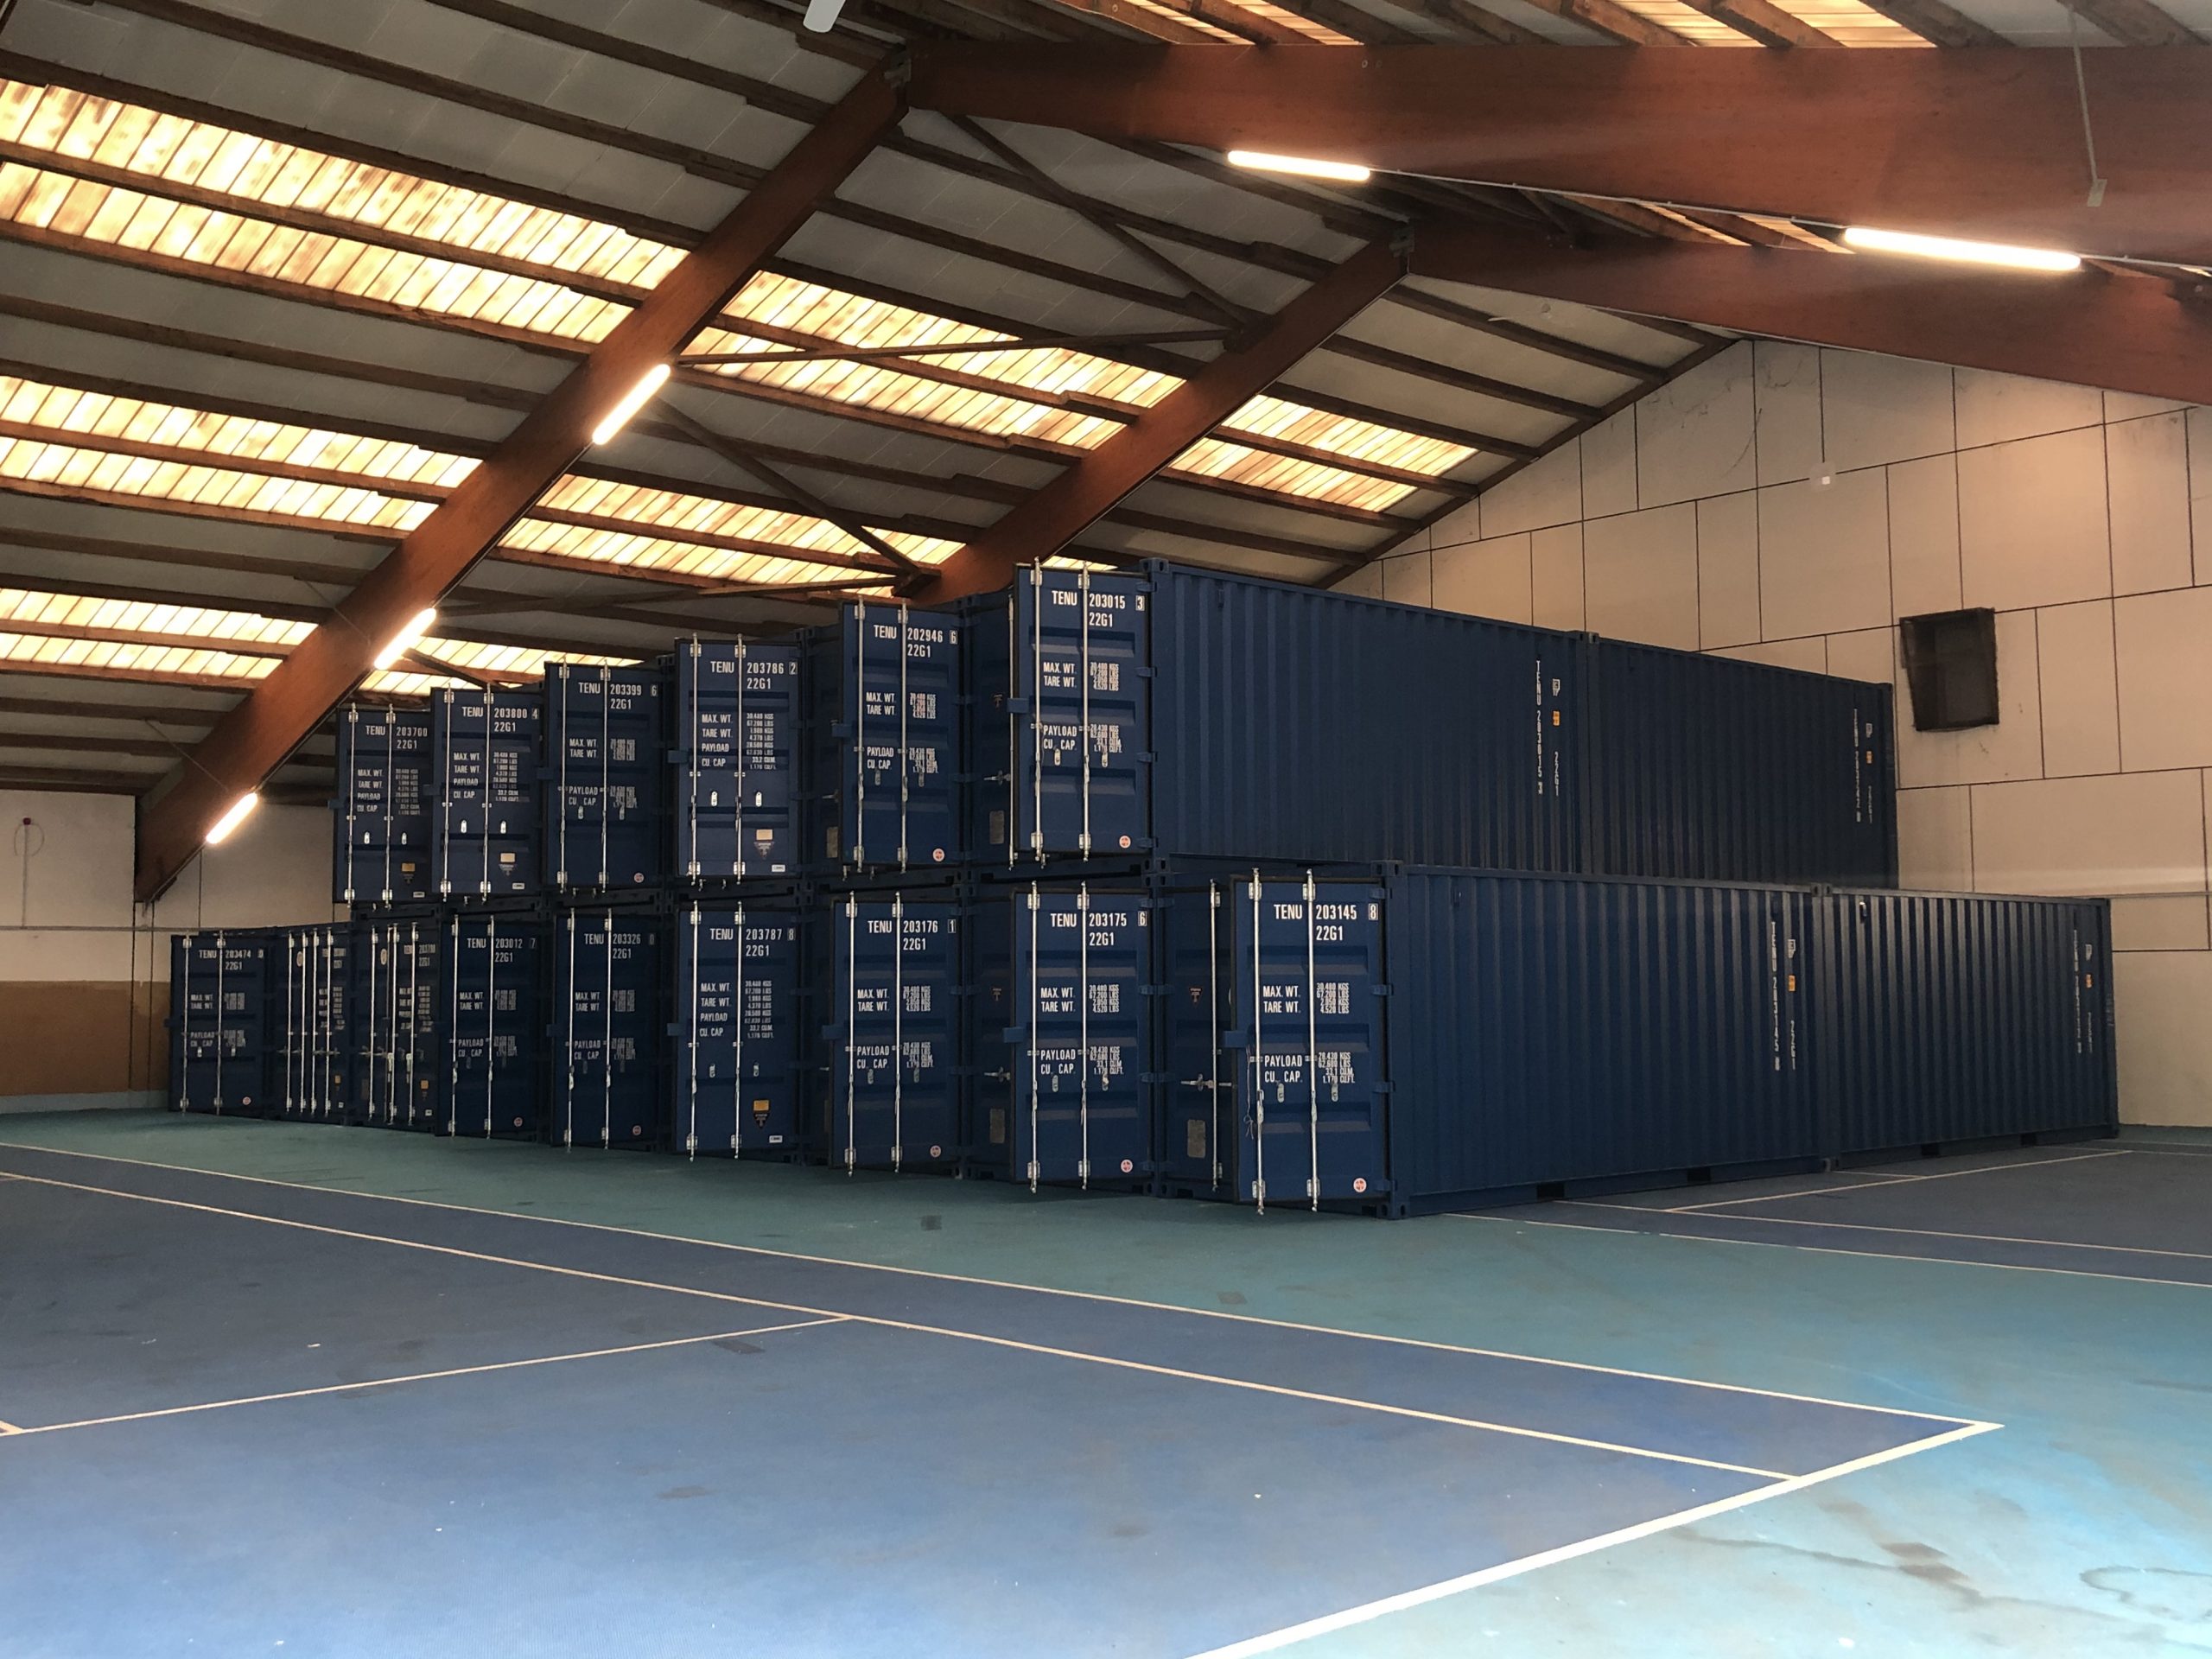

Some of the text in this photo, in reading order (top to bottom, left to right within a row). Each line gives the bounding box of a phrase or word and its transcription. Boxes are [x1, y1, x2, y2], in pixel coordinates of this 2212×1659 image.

[1052, 590, 1077, 606] TENU
[1089, 593, 1125, 610] 203015
[1089, 611, 1113, 628] 22G1
[873, 624, 897, 639] TENU
[907, 627, 944, 643] 202946
[907, 644, 931, 658] 22G1
[710, 661, 734, 674] TENU
[747, 662, 784, 674] 203786
[1043, 661, 1062, 674] MAX.
[747, 677, 771, 690] 22G1
[1044, 675, 1061, 687] TARE
[578, 682, 601, 694] TENU
[610, 684, 642, 696] 203399
[610, 698, 632, 710] 22G1
[867, 705, 882, 715] TARE
[461, 706, 484, 717] TENU
[494, 708, 528, 719] 203800
[366, 726, 386, 736] TENU
[494, 721, 516, 732] 22G1
[1043, 725, 1077, 737] PAYLOAD
[702, 728, 718, 738] TARE
[397, 740, 417, 749] 22G1
[701, 743, 729, 753] PAYLOAD
[570, 749, 584, 758] TARE
[867, 747, 894, 757] PAYLOAD
[454, 765, 467, 773] TARE
[569, 786, 598, 795] PAYLOAD
[1274, 904, 1303, 920] TENU
[1316, 904, 1357, 920] 203145
[1050, 912, 1077, 928] TENU
[1089, 913, 1127, 927] 203175
[868, 920, 892, 934] TENU
[903, 920, 938, 934] 203176
[1316, 925, 1344, 941] 22G1
[584, 933, 605, 945] TENU
[612, 933, 642, 944] 203326
[710, 928, 734, 940] TENU
[745, 928, 782, 941] 203787
[1089, 932, 1115, 946] 22G1
[467, 938, 486, 949] TENU
[495, 938, 523, 949] 203012
[903, 938, 926, 950] 22G1
[199, 949, 217, 959] TENU
[613, 948, 632, 960] 22G1
[745, 944, 770, 957] 22G1
[495, 952, 513, 963] 22G1
[1263, 985, 1284, 998] MAX.
[575, 1003, 588, 1011] TARE
[701, 998, 716, 1007] TARE
[858, 1001, 874, 1012] TARE
[1041, 1001, 1058, 1013] TARE
[1263, 1001, 1282, 1013] TARE
[700, 1013, 728, 1022] PAYLOAD
[458, 1038, 484, 1047] PAYLOAD
[574, 1040, 601, 1049] PAYLOAD
[857, 1046, 890, 1056] PAYLOAD
[1041, 1049, 1076, 1061] PAYLOAD
[1265, 1055, 1303, 1067] PAYLOAD
